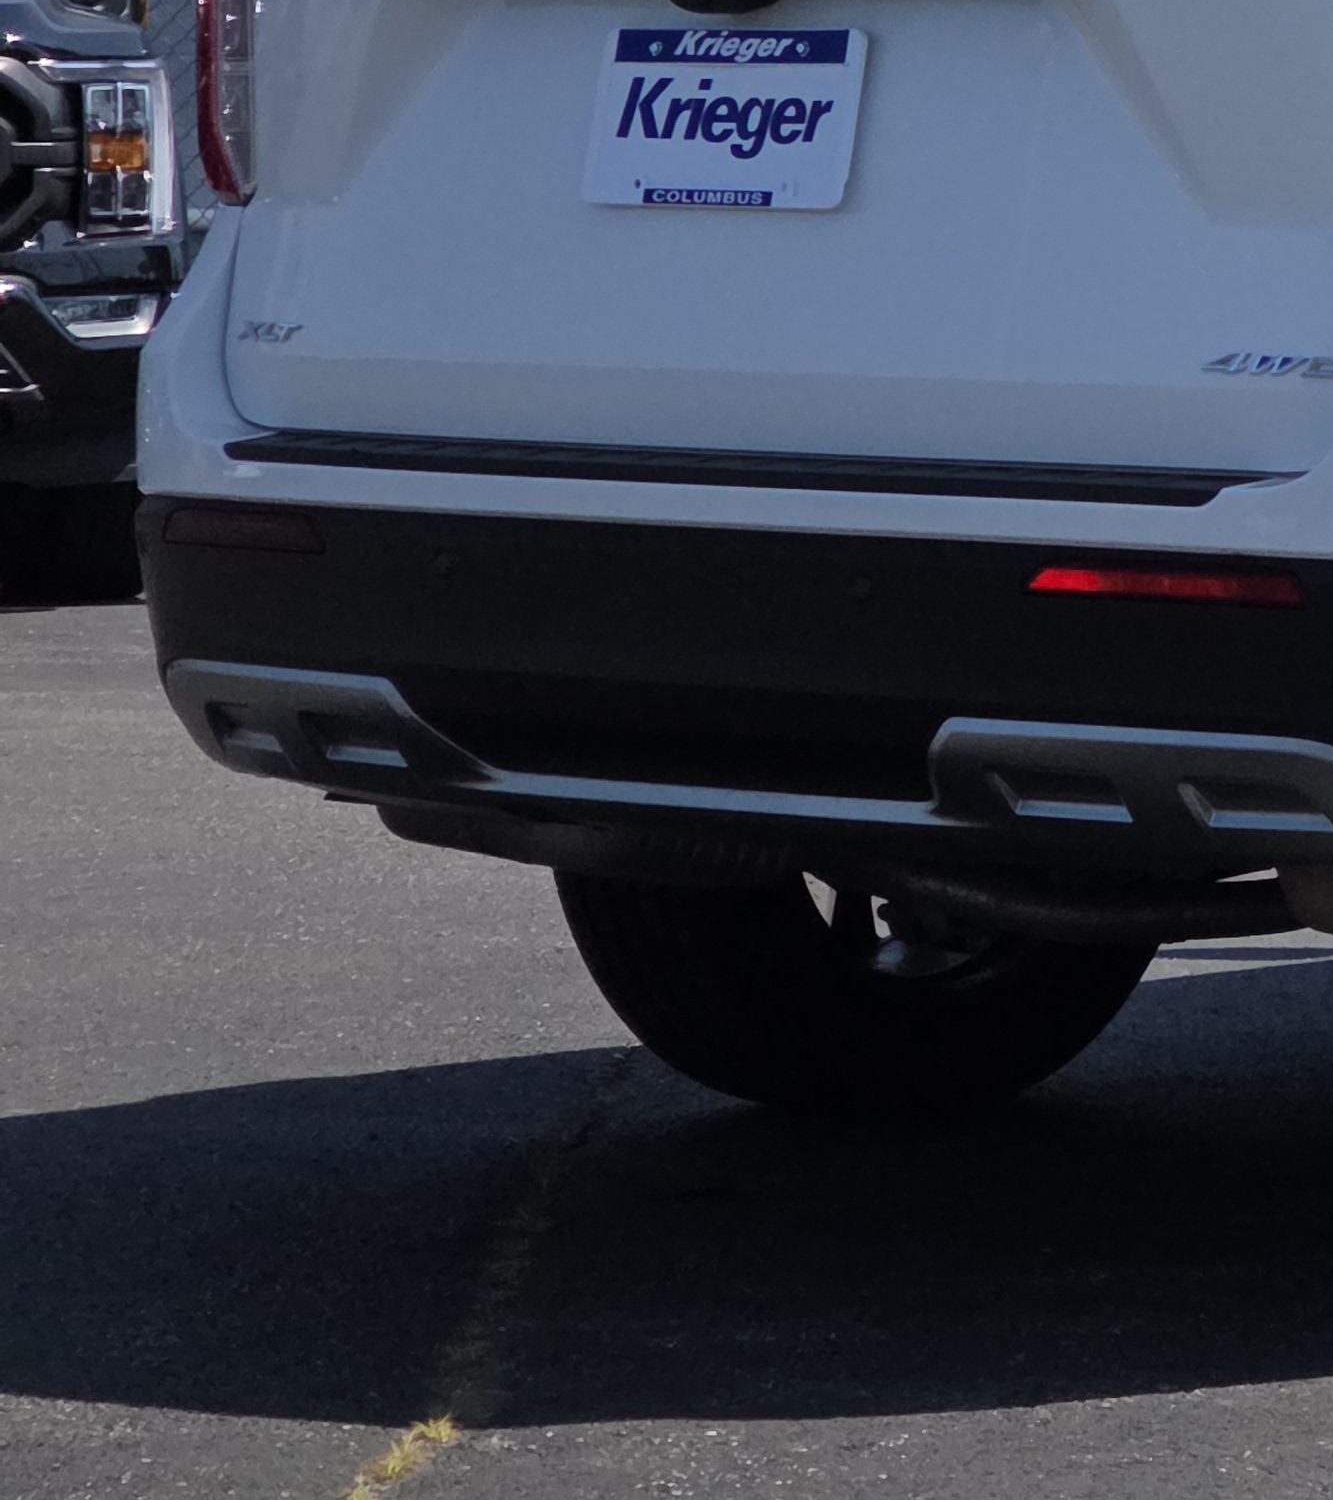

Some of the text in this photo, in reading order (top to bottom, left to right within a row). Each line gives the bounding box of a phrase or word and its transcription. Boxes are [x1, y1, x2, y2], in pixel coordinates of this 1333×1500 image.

[674, 30, 794, 62] Krieger
[616, 77, 834, 159] Krieger
[651, 189, 763, 204] COLUMBUS
[239, 321, 304, 343] XLT
